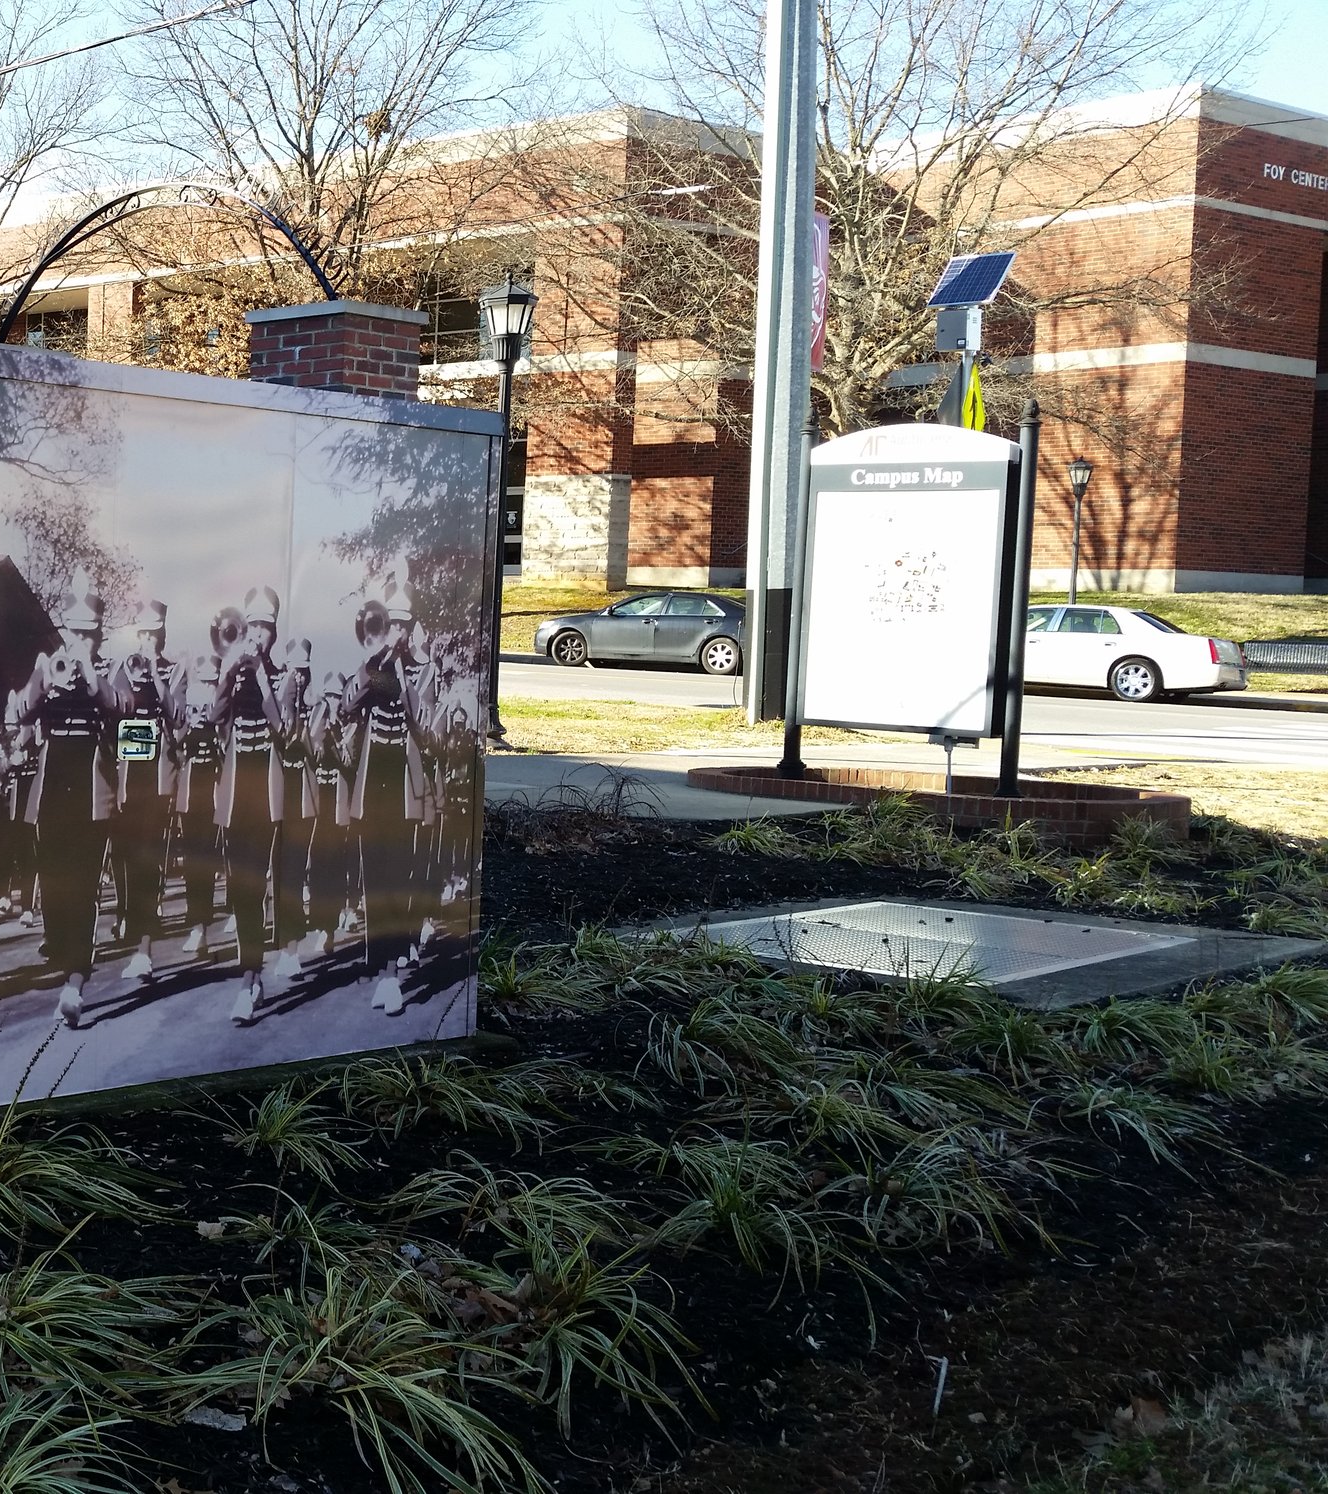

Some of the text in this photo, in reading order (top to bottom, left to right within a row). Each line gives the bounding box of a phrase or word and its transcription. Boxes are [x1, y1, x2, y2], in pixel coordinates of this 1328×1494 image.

[1263, 162, 1286, 181] FOY
[850, 466, 964, 489] Campus Map
